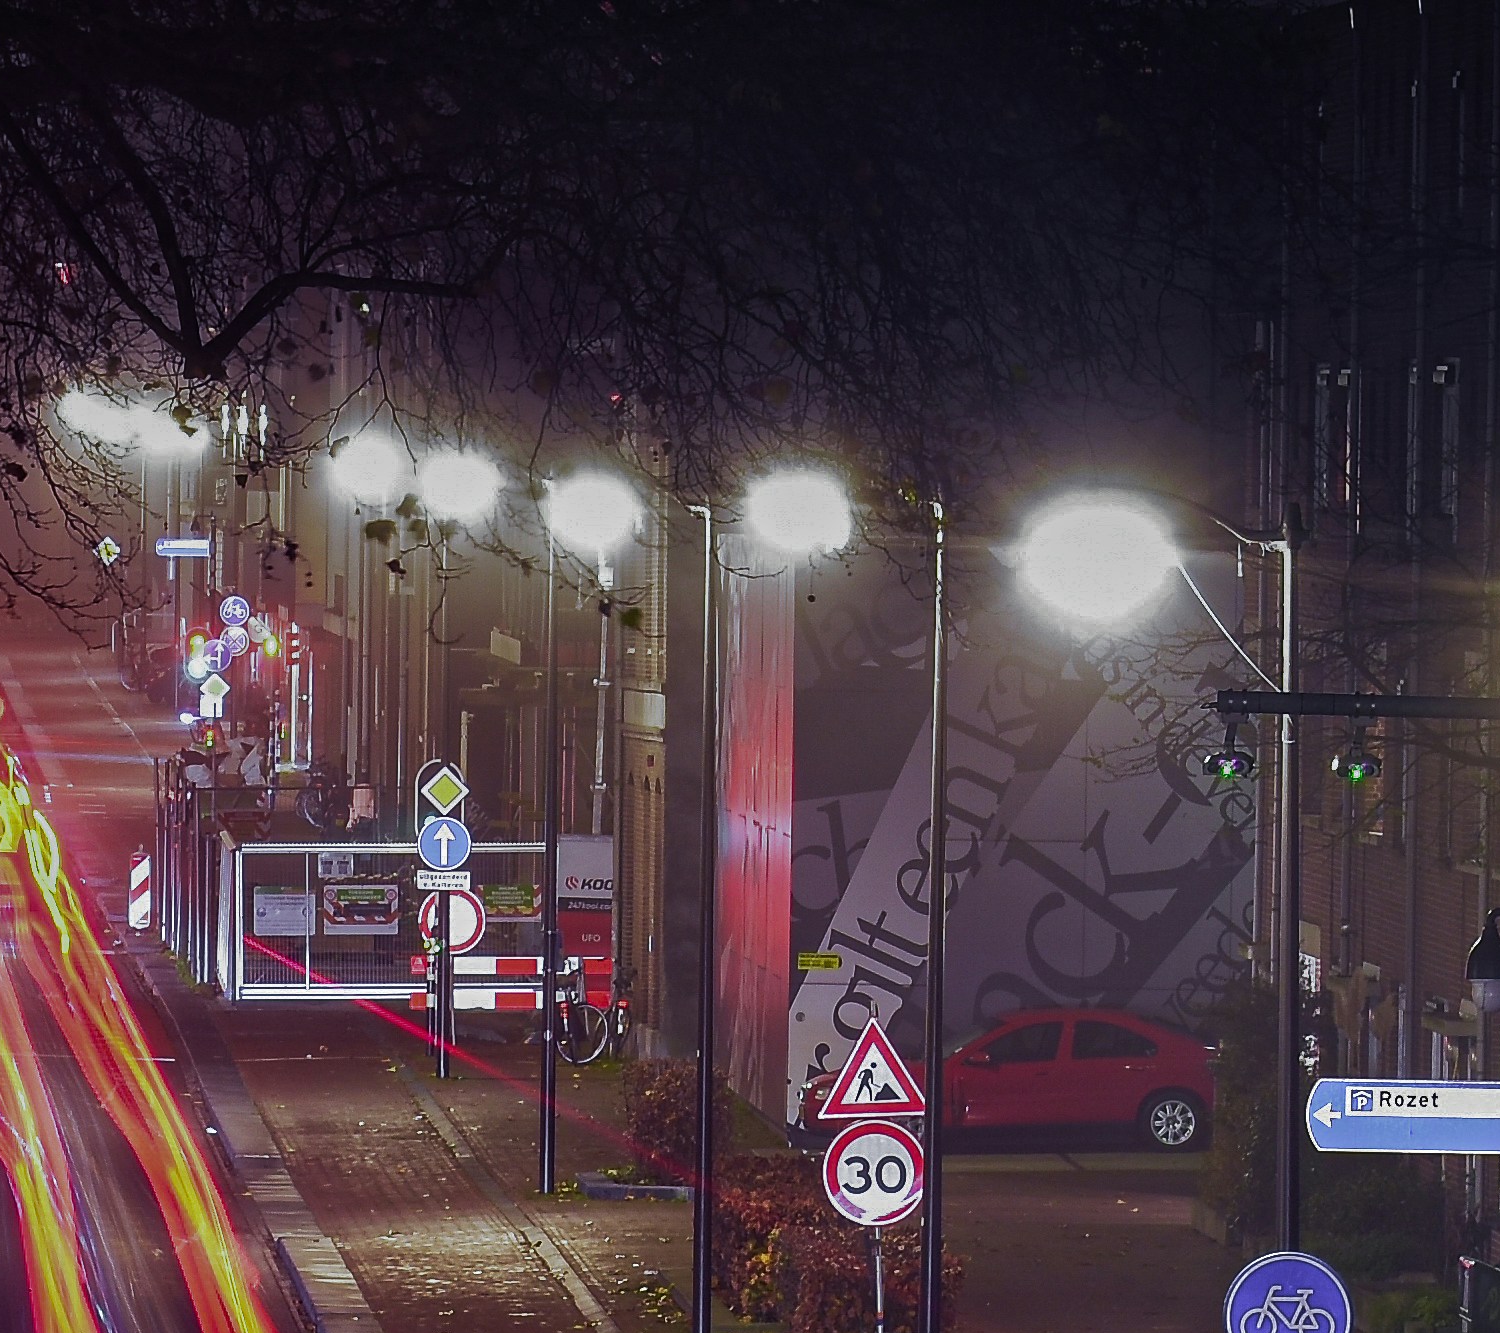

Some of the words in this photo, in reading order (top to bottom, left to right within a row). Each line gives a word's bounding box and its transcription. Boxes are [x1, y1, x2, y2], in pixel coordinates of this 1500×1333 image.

[582, 933, 601, 942] UFO
[1379, 1090, 1439, 1108] Rozet
[842, 1155, 907, 1195] 30
